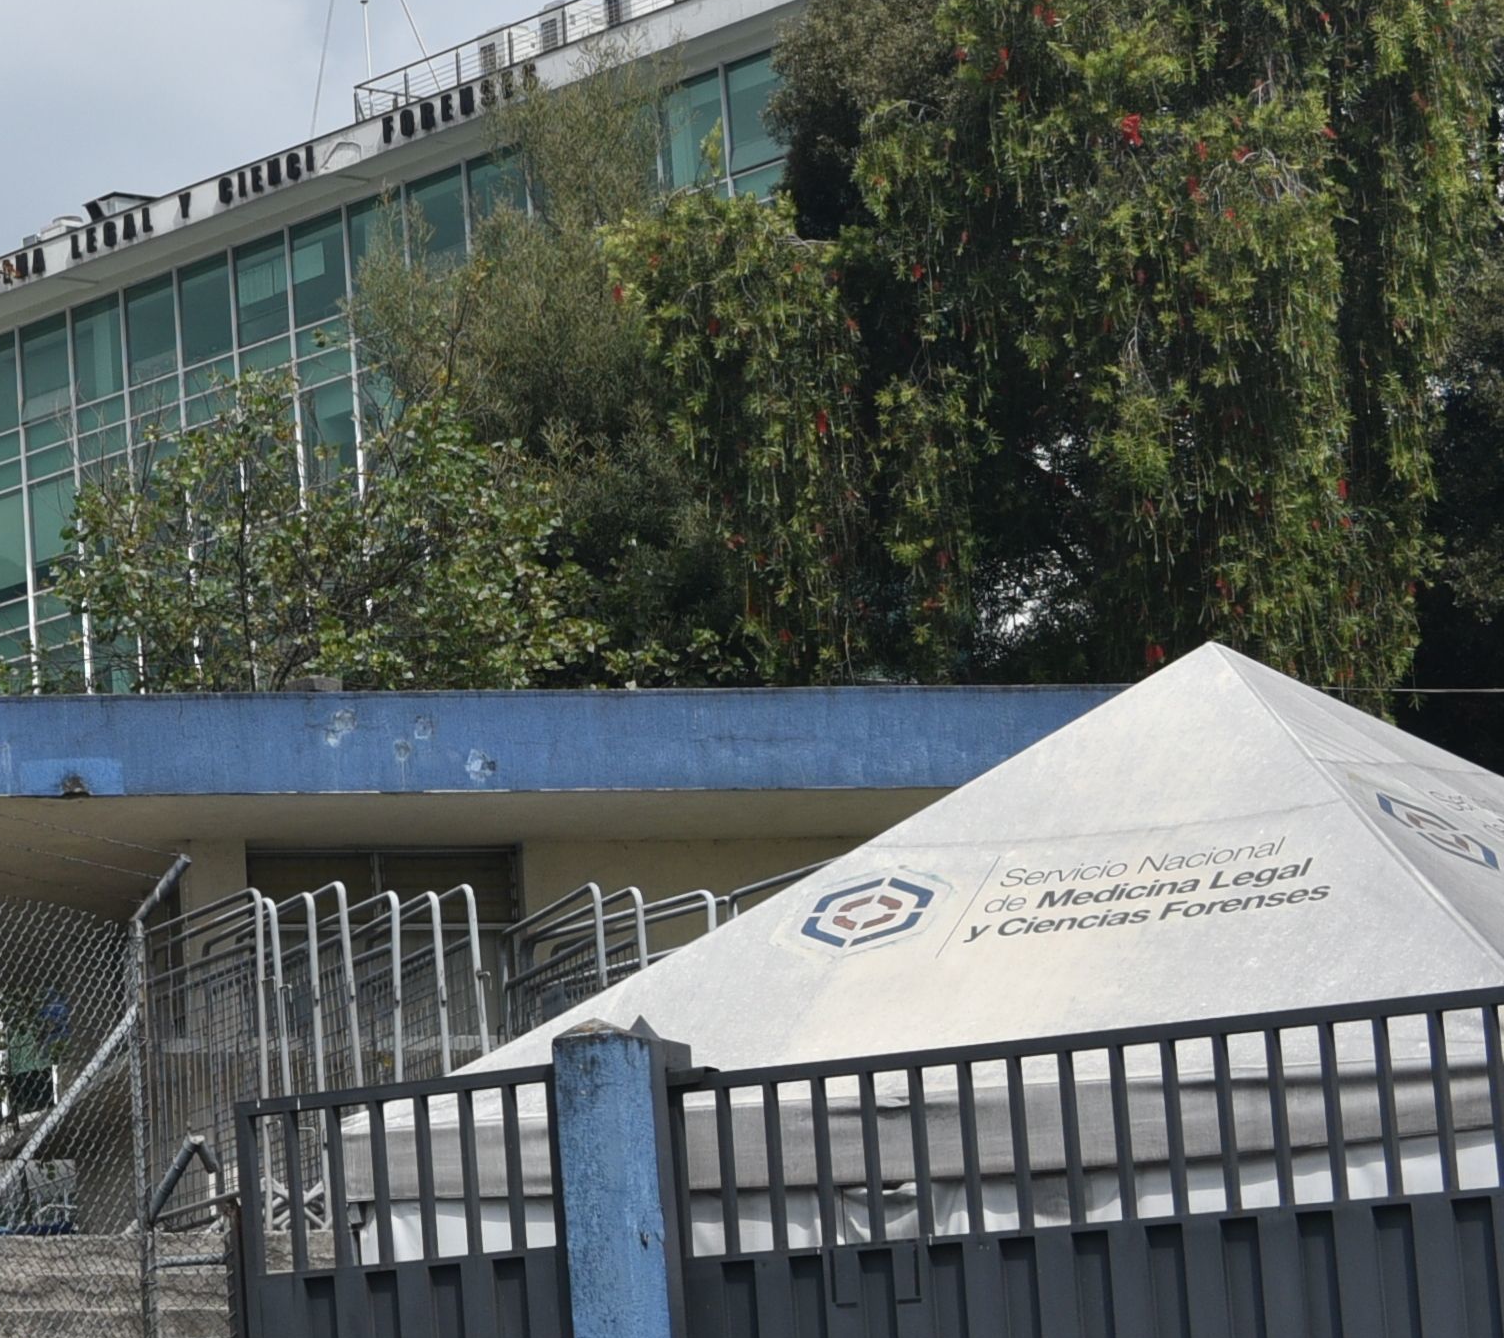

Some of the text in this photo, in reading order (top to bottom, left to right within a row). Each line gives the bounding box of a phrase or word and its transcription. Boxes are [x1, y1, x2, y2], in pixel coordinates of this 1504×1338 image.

[70, 207, 155, 261] LEGAL
[178, 191, 192, 219] Y
[983, 857, 1314, 915] de Medicina Legal
[999, 836, 1287, 889] Servicio Nacional
[962, 882, 1333, 944] y Ciencias Forenses
